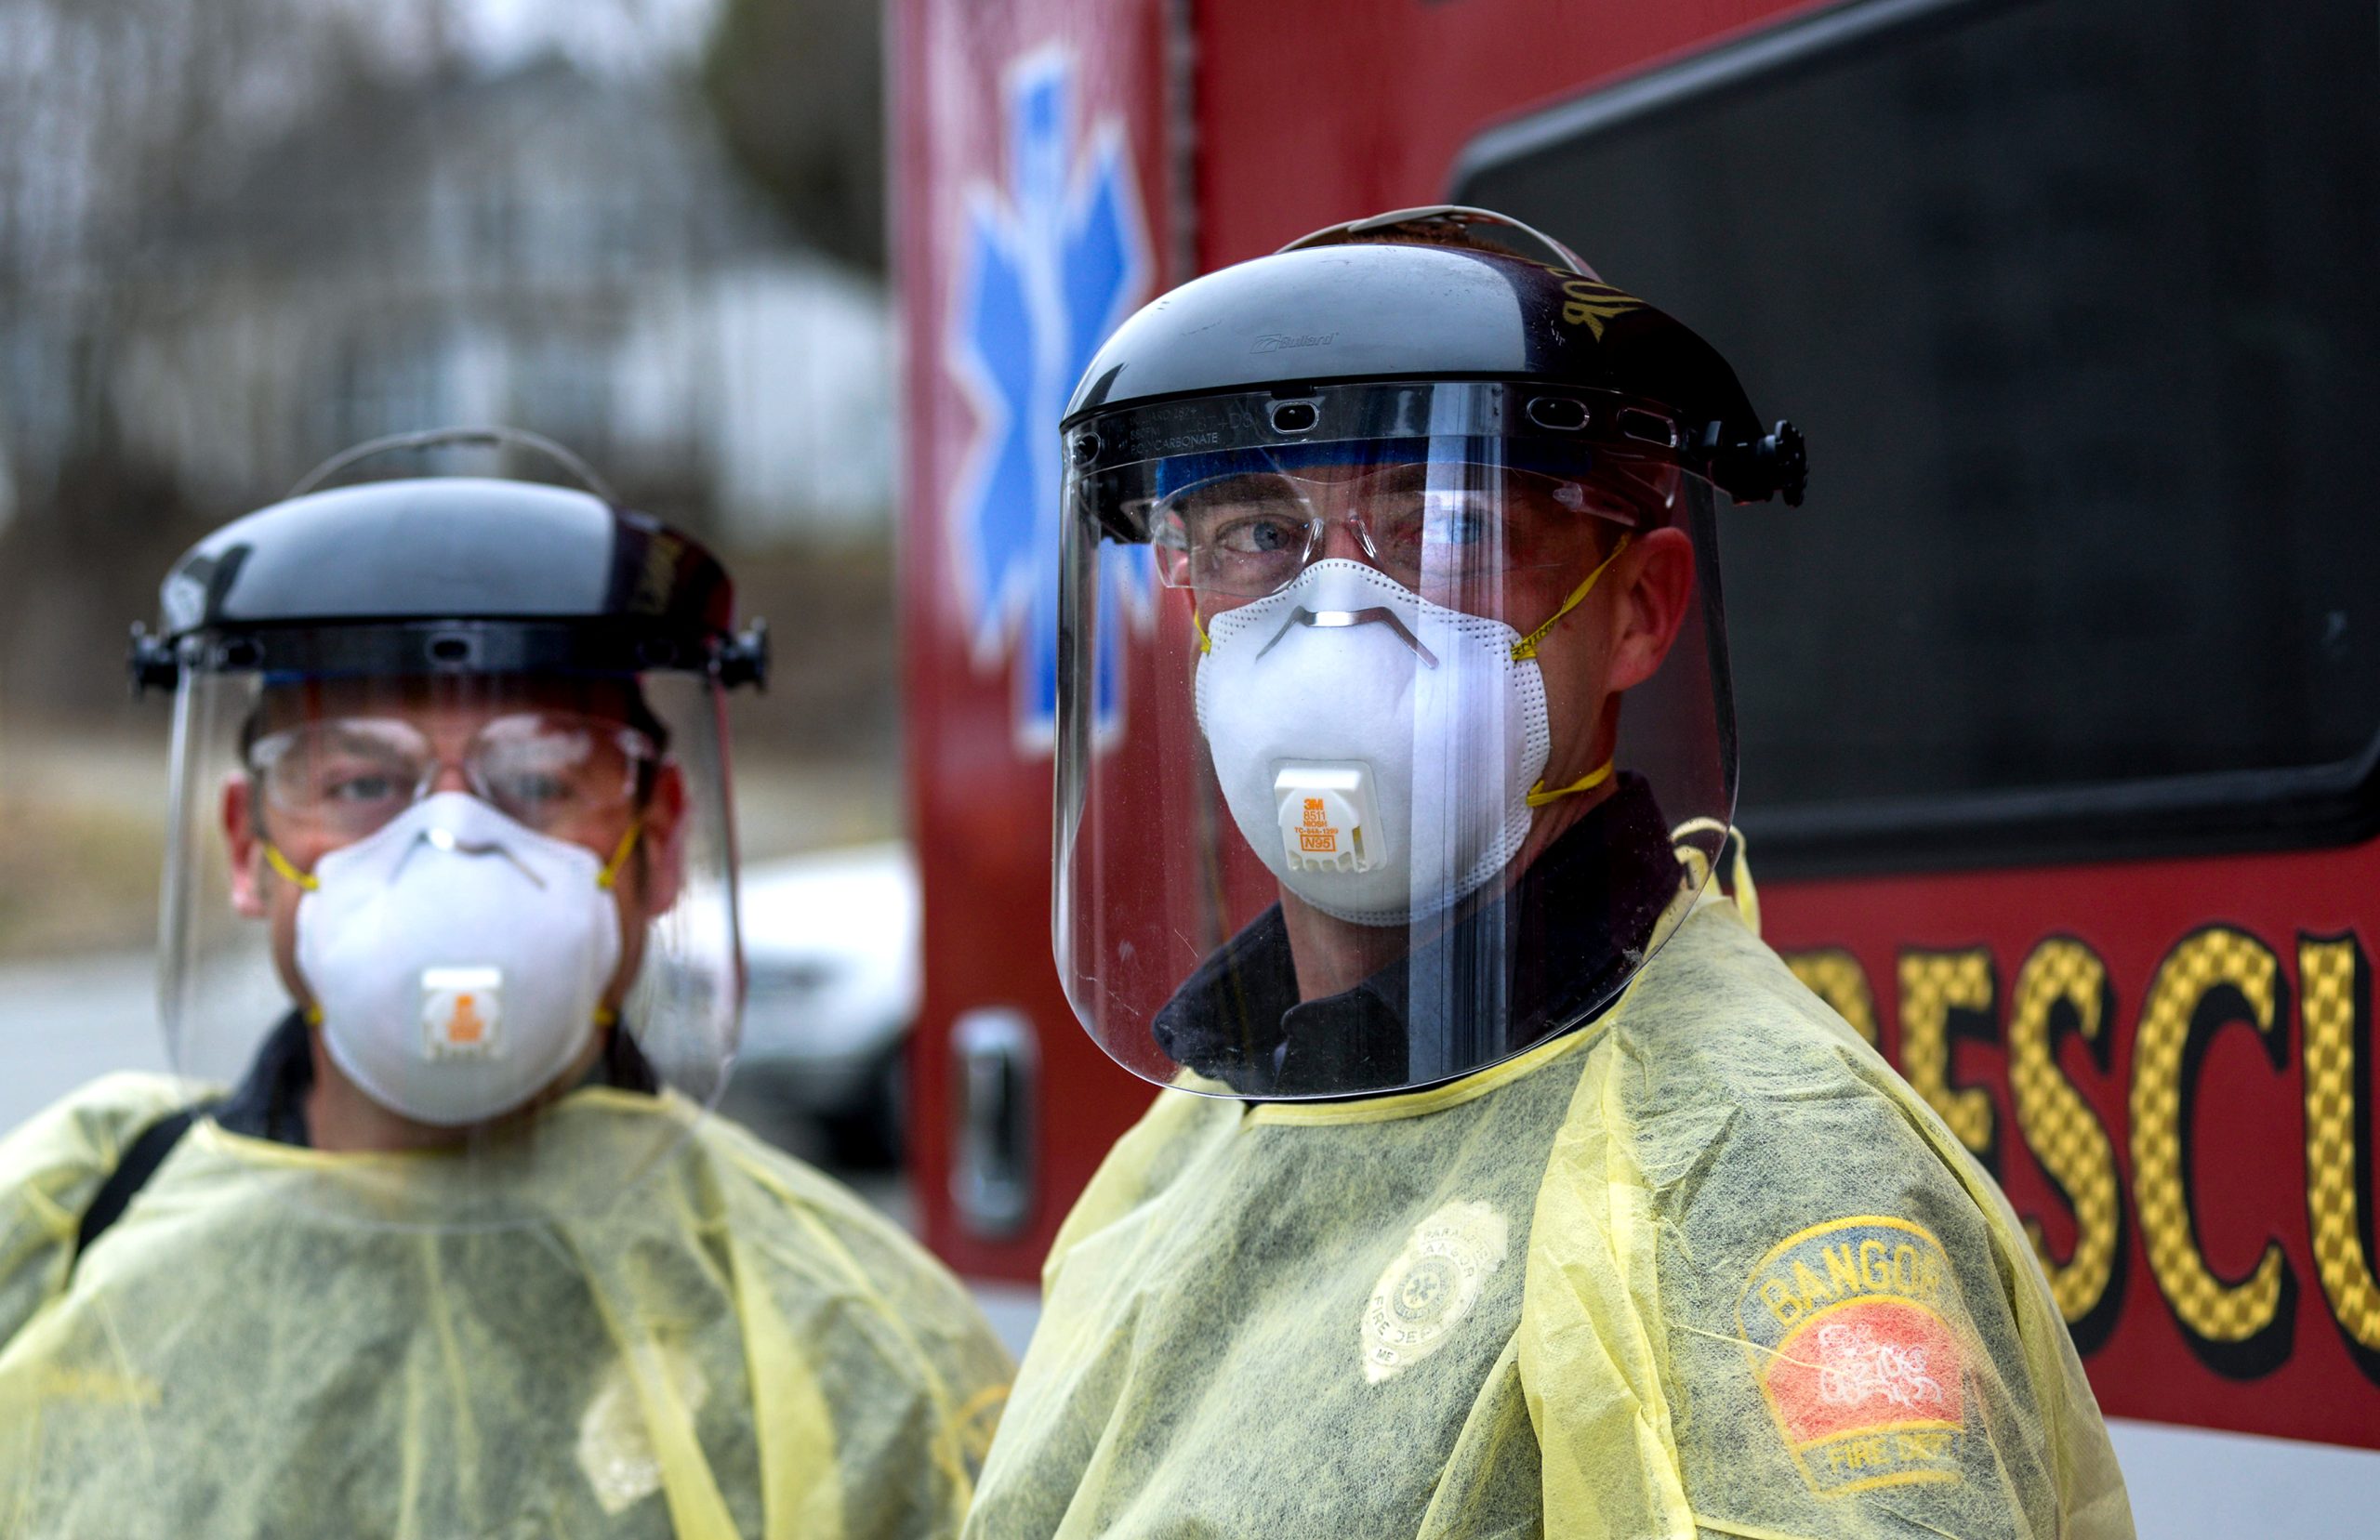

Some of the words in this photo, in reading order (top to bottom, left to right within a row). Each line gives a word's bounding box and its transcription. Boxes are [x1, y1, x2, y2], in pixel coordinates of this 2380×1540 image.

[1279, 333, 1335, 349] Bullard
[1303, 797, 1323, 810] 3M
[1303, 810, 1325, 820] 8511
[1305, 837, 1330, 849] N95
[1760, 1238, 1940, 1326] BANGOR
[1372, 1295, 1391, 1336] FIRE
[1376, 1349, 1395, 1361] ME
[1828, 1438, 1891, 1474] FIRE
